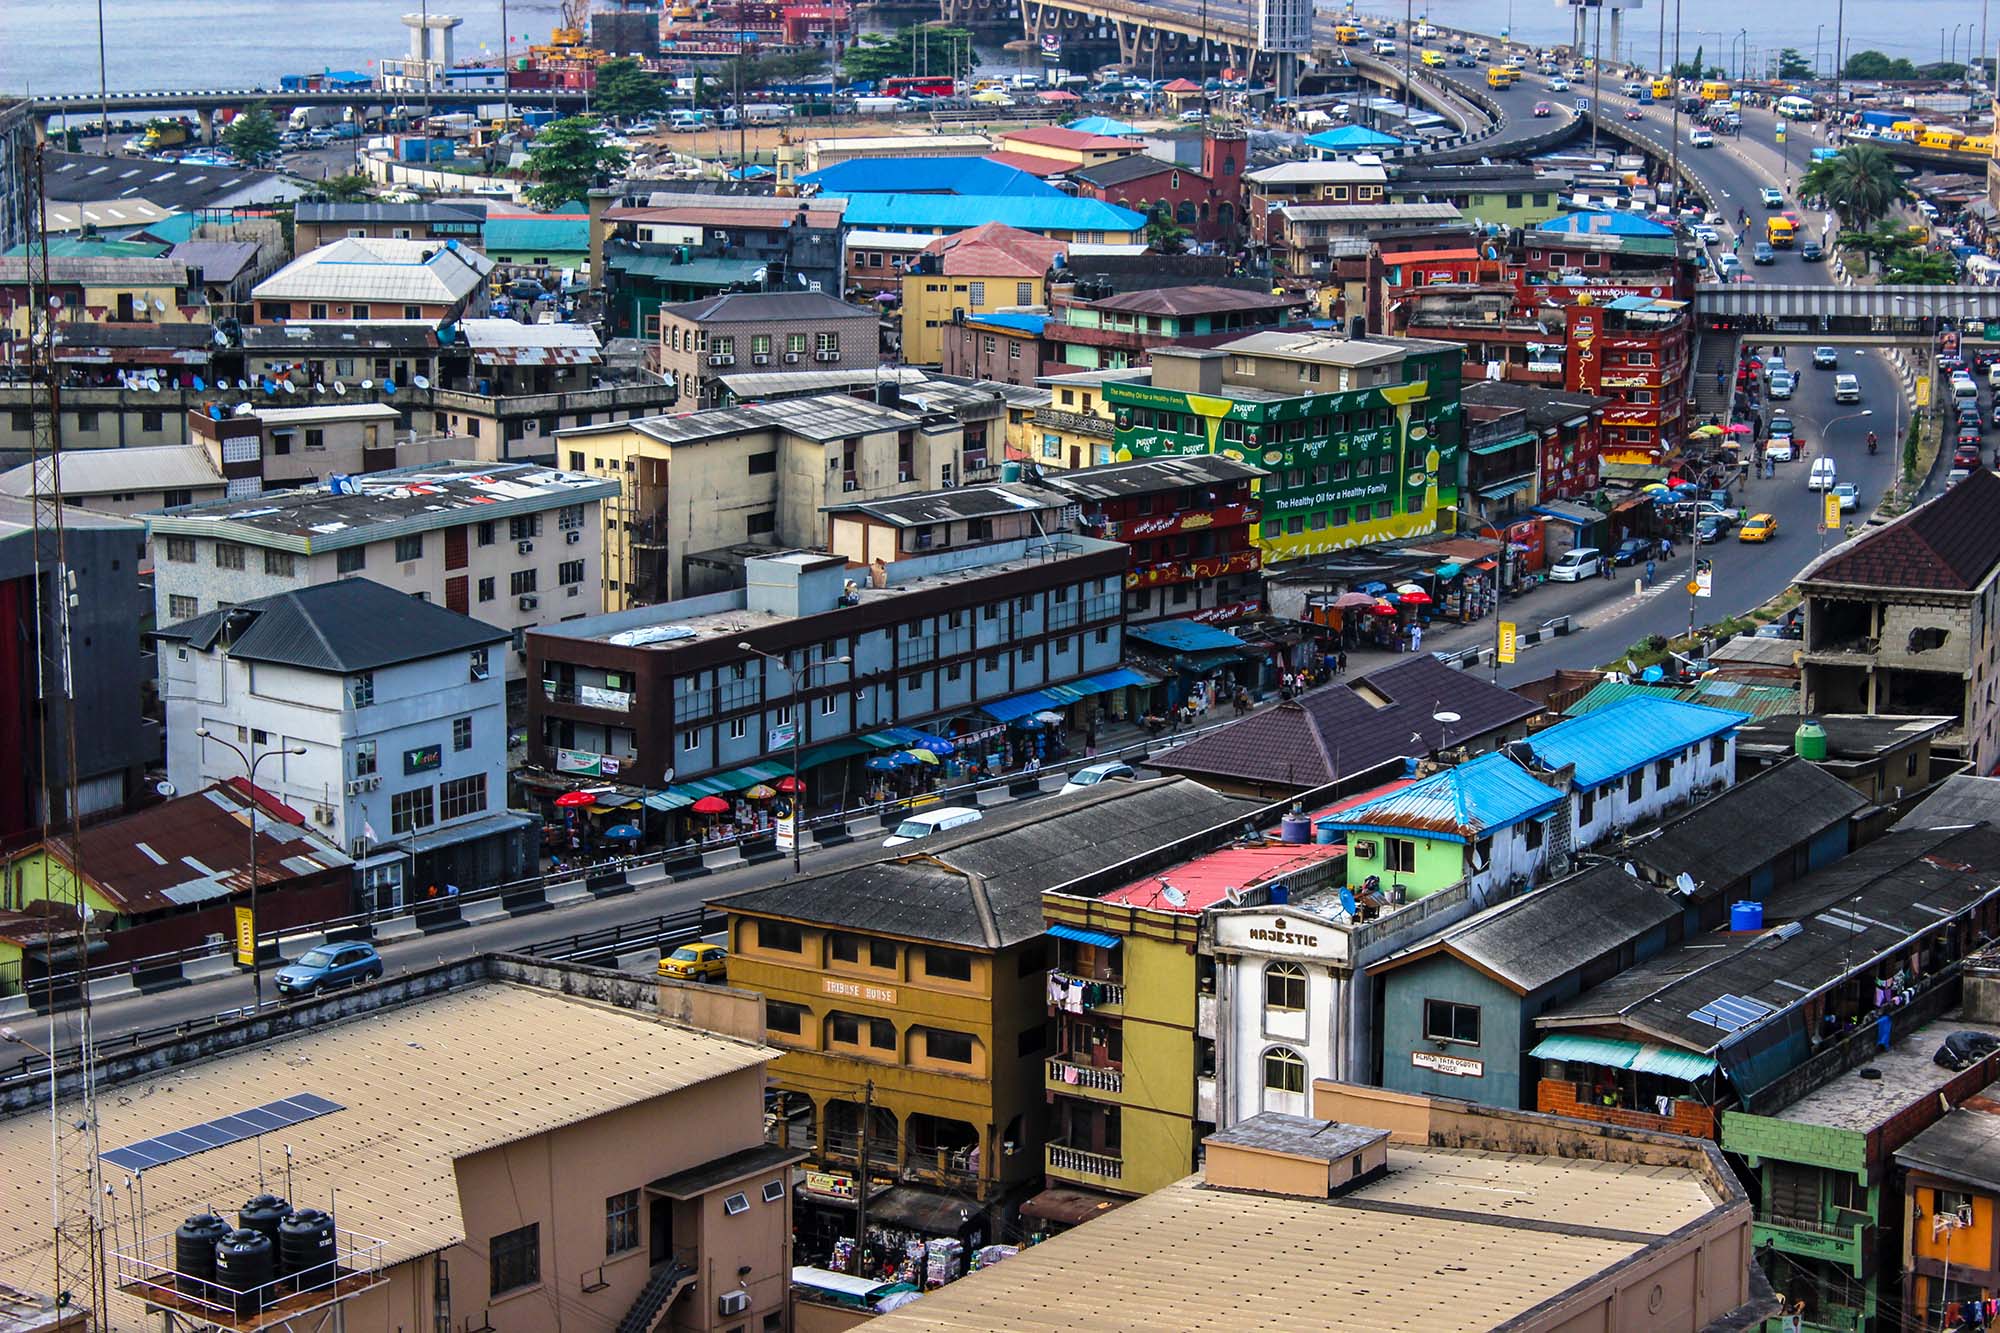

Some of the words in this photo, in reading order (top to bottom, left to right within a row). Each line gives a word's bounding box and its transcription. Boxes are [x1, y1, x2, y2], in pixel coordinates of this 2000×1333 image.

[1276, 500, 1289, 510] The
[1289, 495, 1315, 508] Healthy
[1315, 493, 1325, 503] Oil
[1325, 491, 1336, 502] for
[1342, 486, 1366, 499] Healthy
[1367, 482, 1388, 495] Family
[1249, 928, 1318, 948] MAJESTIC
